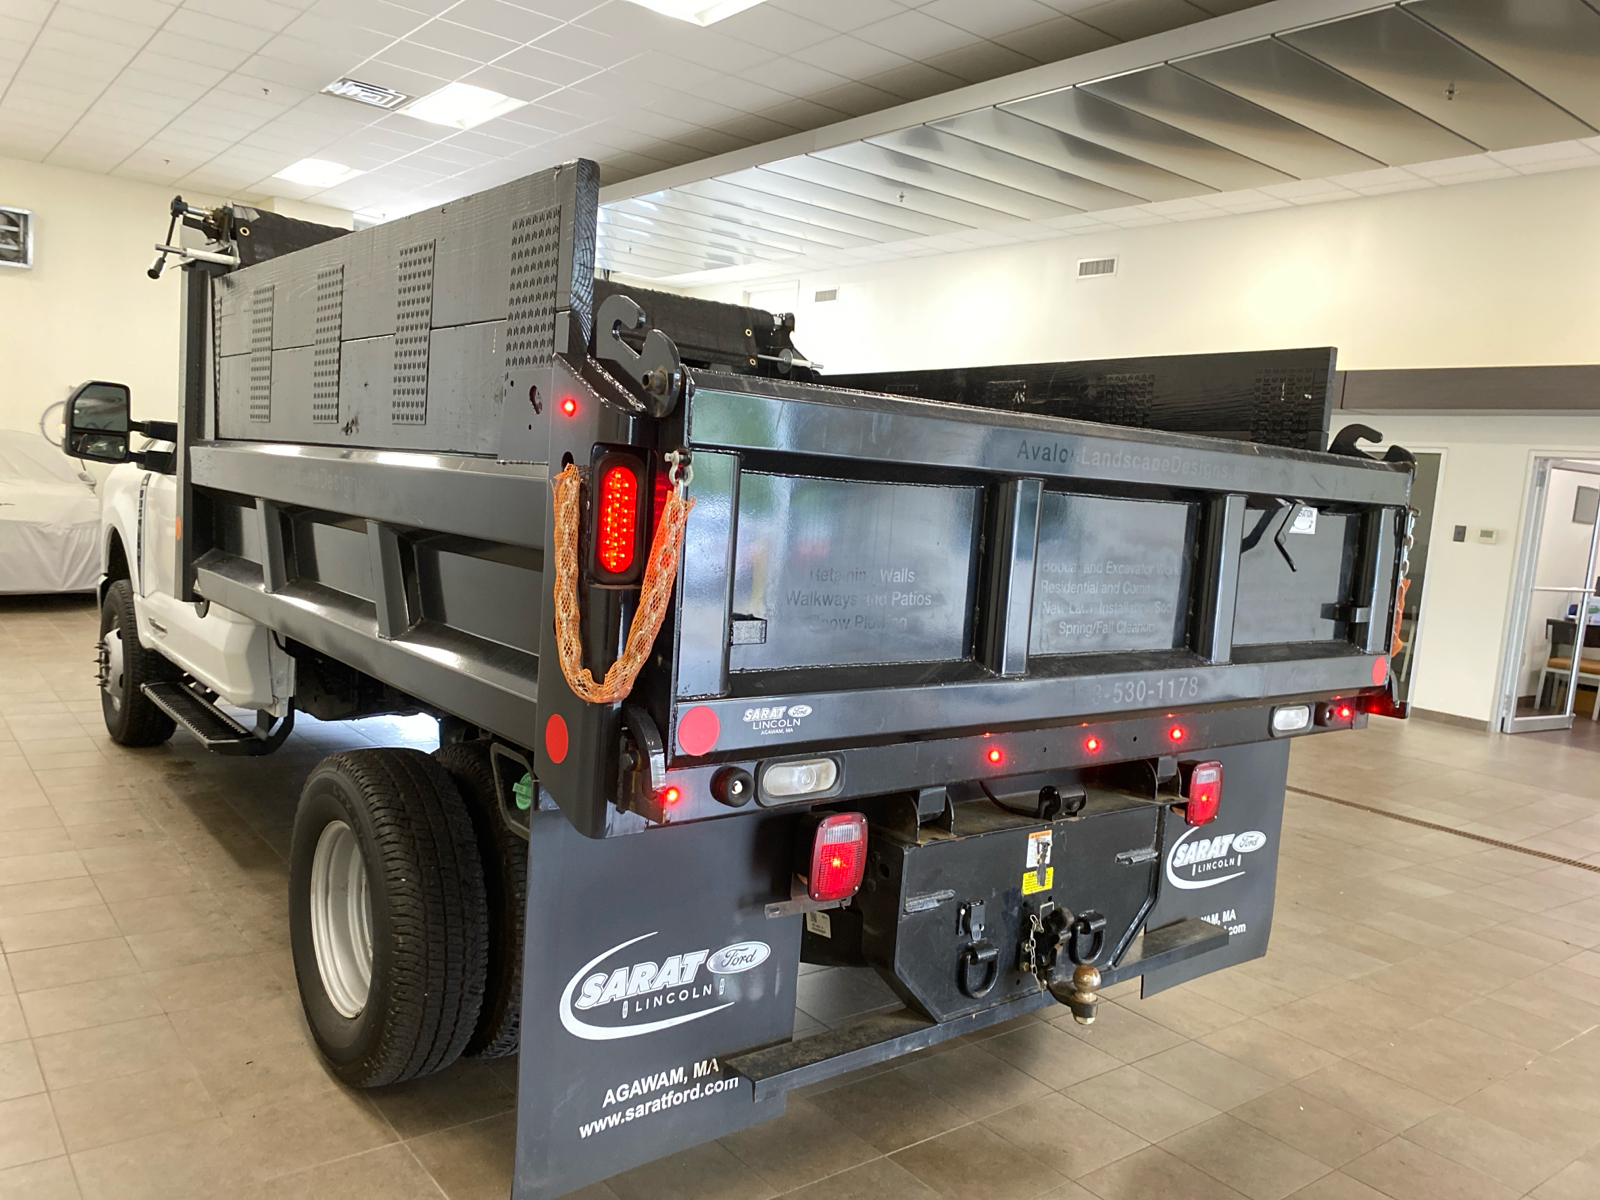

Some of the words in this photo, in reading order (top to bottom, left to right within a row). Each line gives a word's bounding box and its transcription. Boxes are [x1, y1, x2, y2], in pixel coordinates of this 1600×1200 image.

[879, 567, 915, 583] Walls
[1083, 560, 1103, 574] and
[1105, 560, 1154, 575] Excavator
[1040, 579, 1099, 595] Residential
[1101, 580, 1121, 595] and
[785, 589, 858, 609] Walkways
[891, 590, 932, 606] Patios
[1058, 620, 1115, 637] Spring/Fall
[1116, 620, 1155, 636] Cleanup
[742, 705, 787, 722] SARAT
[752, 718, 801, 730] LINCOLN
[1173, 833, 1236, 868] SARAT
[1197, 857, 1235, 873] LINCOLN
[1221, 908, 1238, 924] MA
[574, 948, 710, 1010] SARAT
[634, 983, 713, 1013] LINCOLN
[601, 1066, 689, 1109] AGAWAM,
[692, 1057, 720, 1080] MA
[578, 1076, 740, 1140] www.saratford.com
